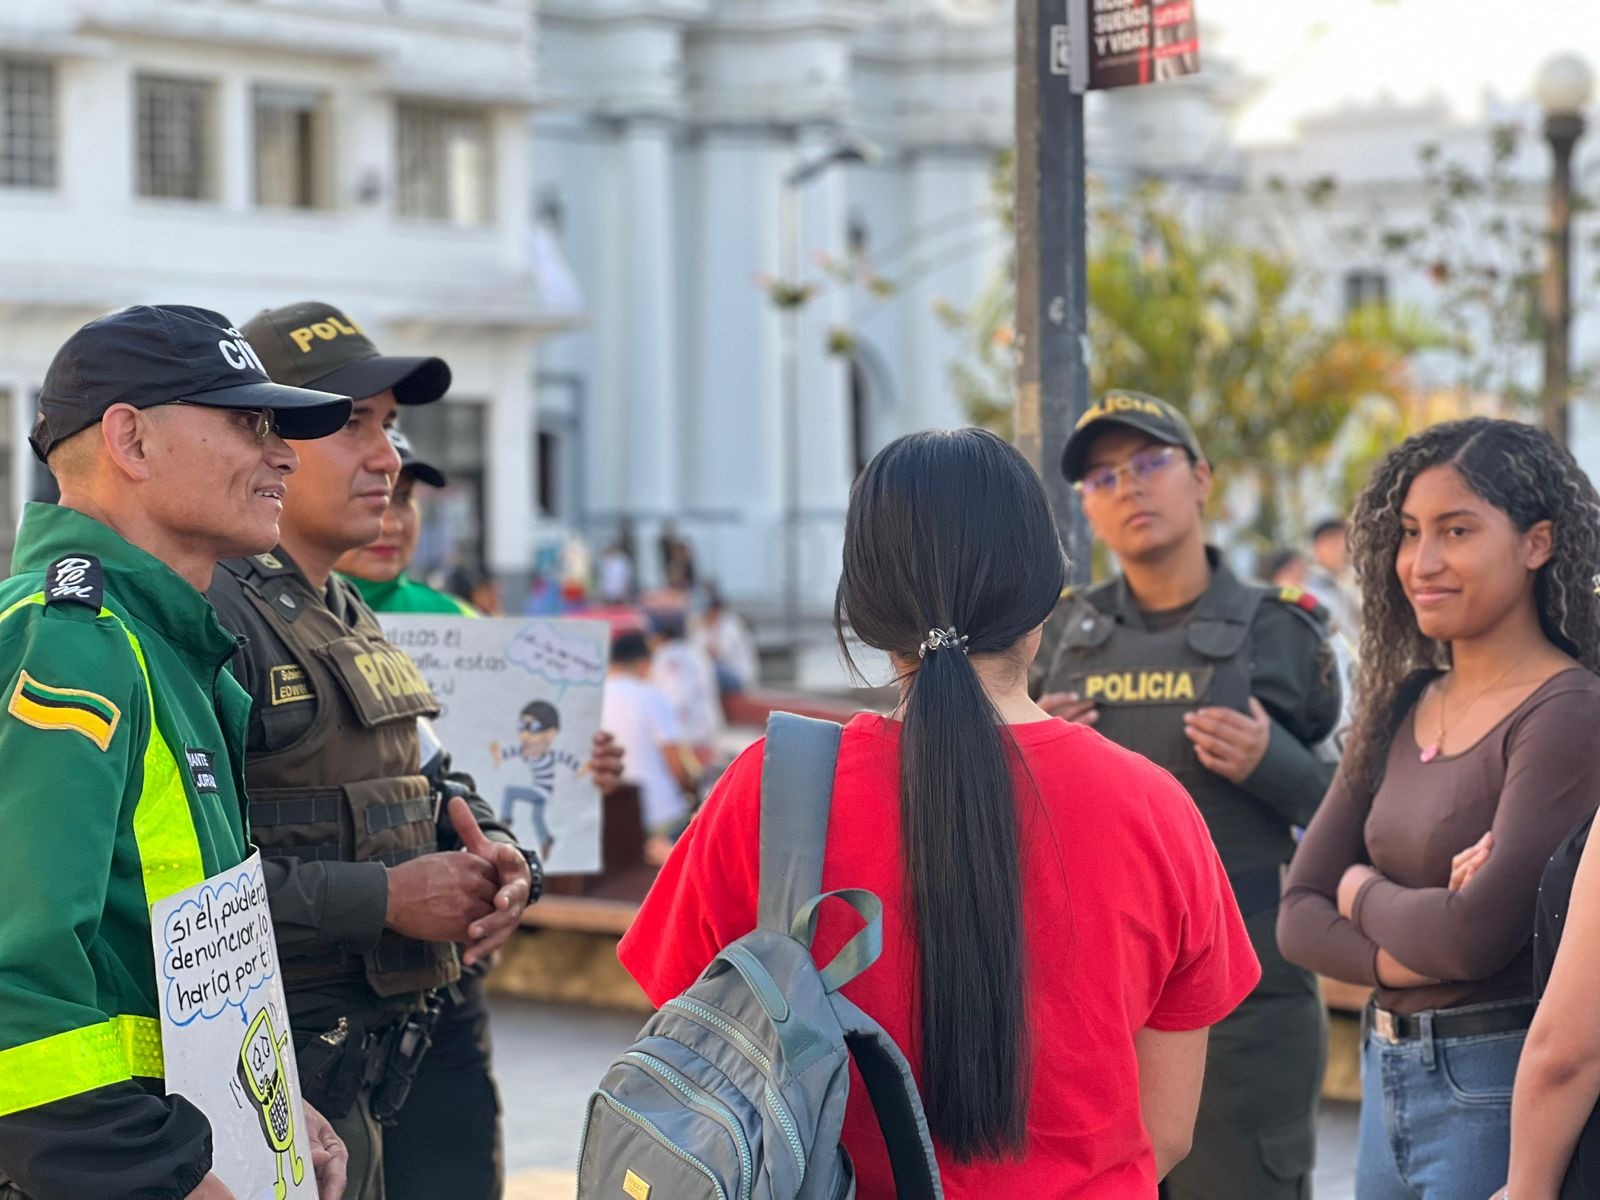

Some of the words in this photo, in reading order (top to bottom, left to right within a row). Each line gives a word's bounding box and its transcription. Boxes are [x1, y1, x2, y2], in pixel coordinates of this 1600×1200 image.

[1086, 671, 1195, 701] POLICIA
[176, 969, 231, 1011] haría
[235, 956, 258, 992] por
[260, 942, 272, 968] ti
